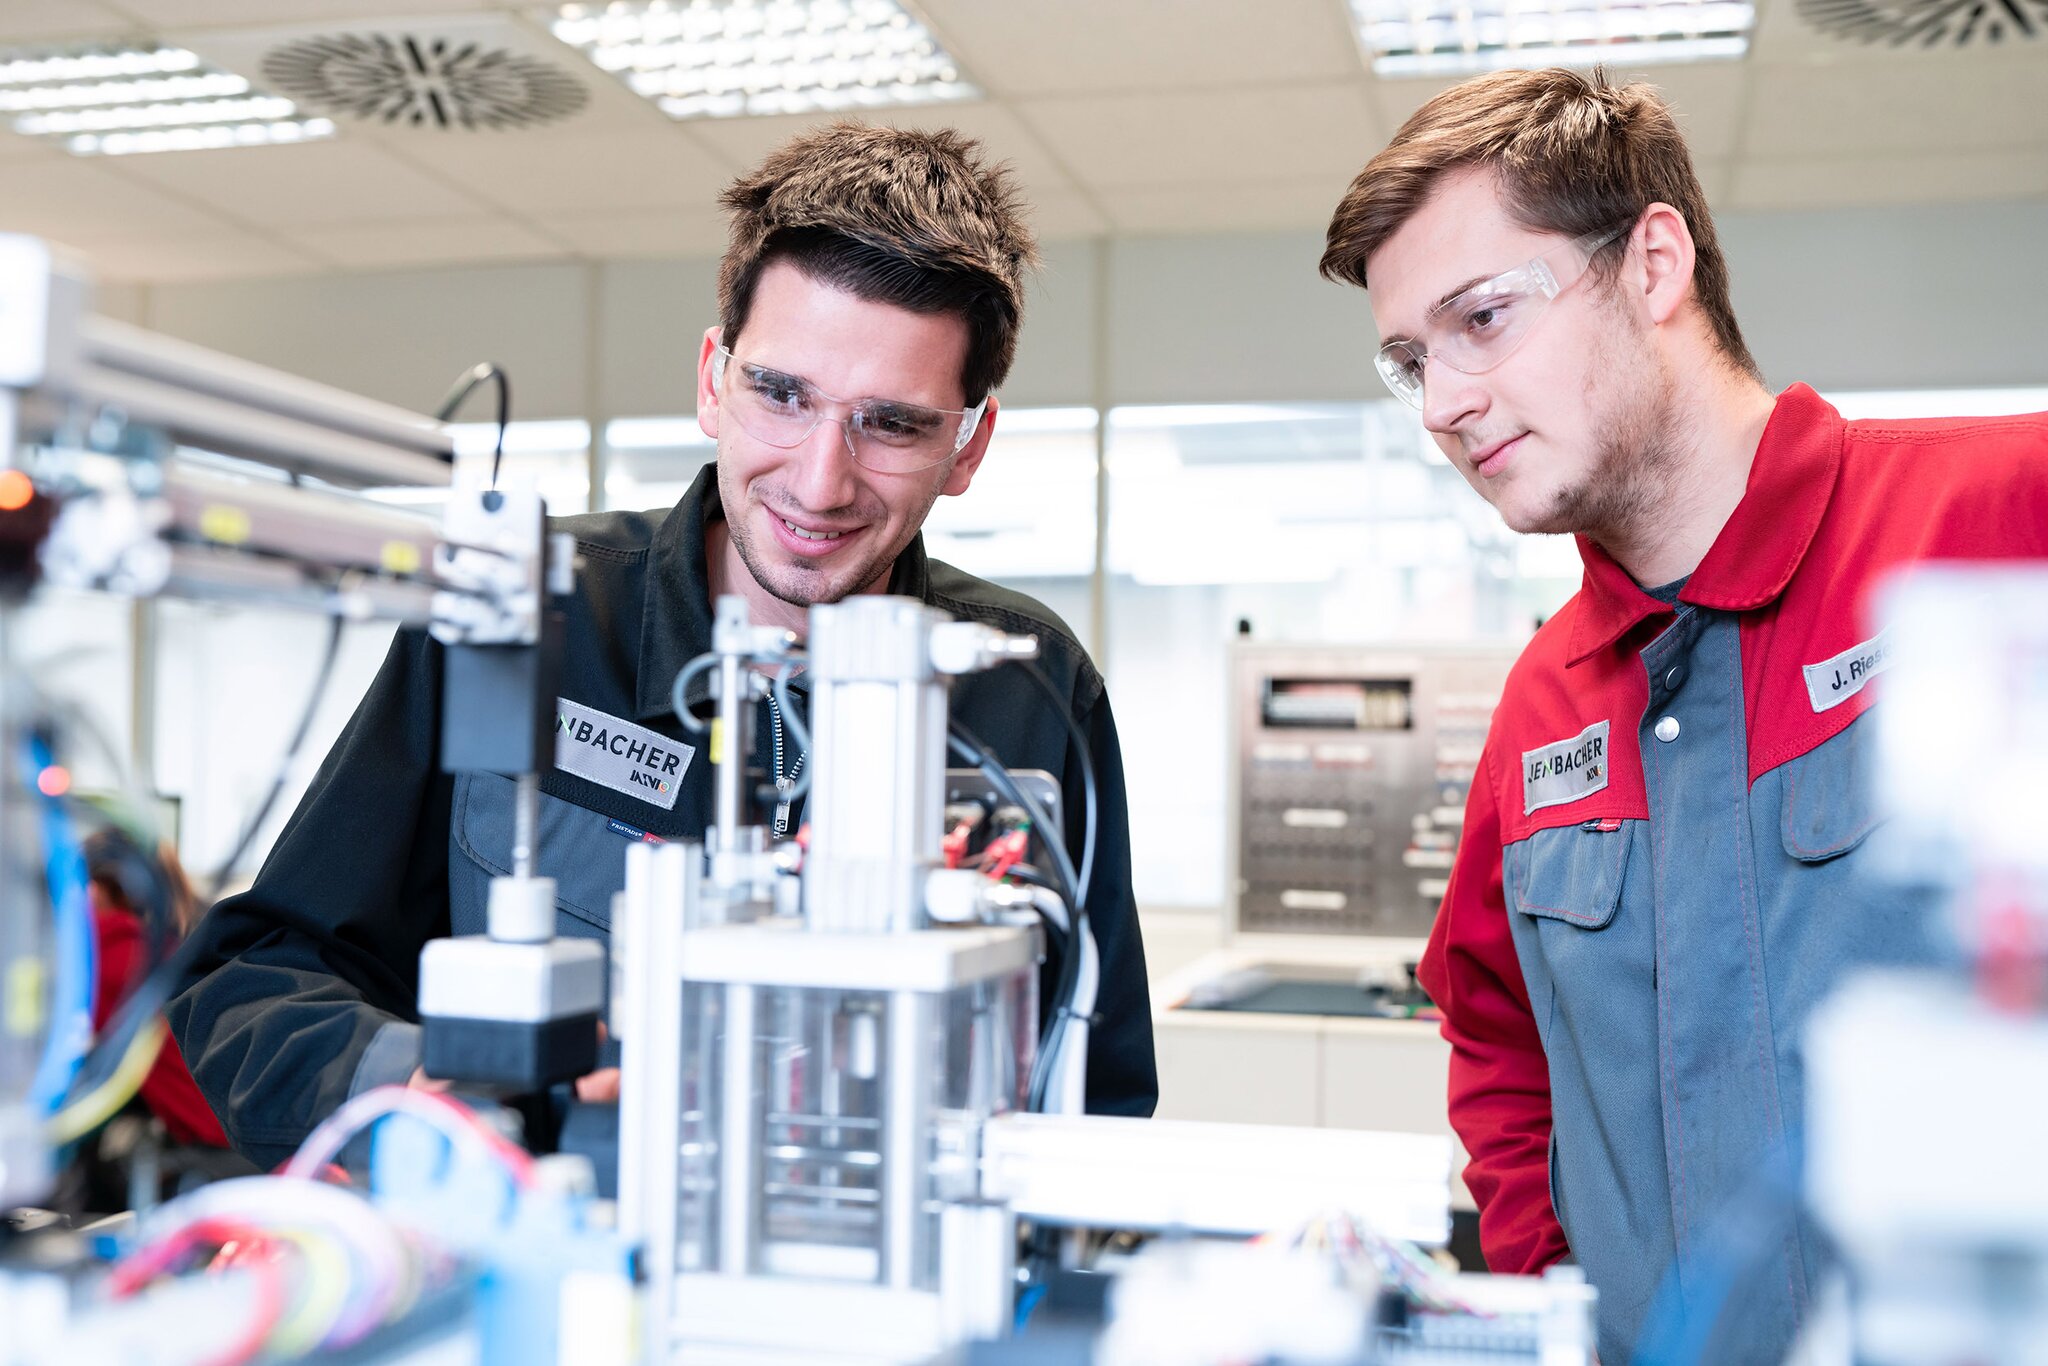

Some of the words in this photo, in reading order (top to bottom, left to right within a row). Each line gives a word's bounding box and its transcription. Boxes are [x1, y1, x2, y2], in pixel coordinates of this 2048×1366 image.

[1831, 670, 1848, 690] J.
[555, 712, 681, 776] NBACHER
[1528, 736, 1603, 783] JENBACHER
